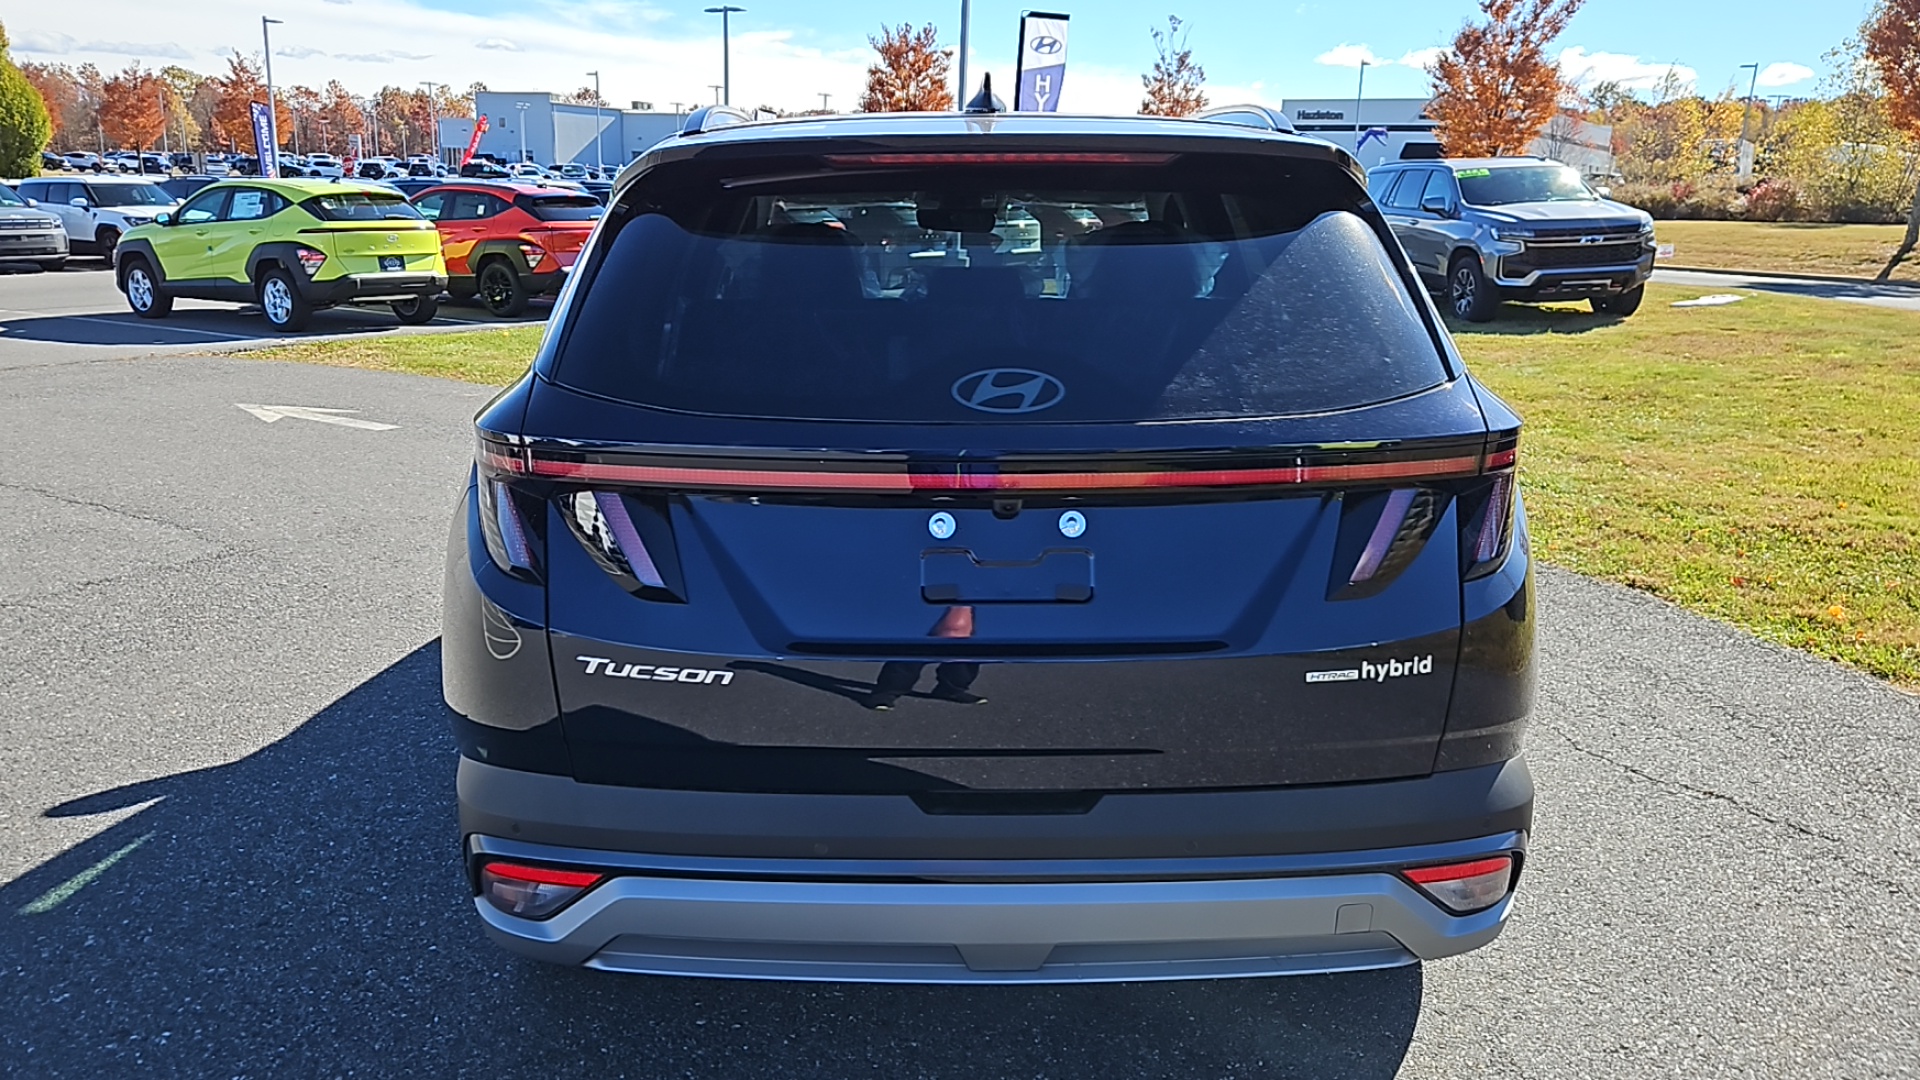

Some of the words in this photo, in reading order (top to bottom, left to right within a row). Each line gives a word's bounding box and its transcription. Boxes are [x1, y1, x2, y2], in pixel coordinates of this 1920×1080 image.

[1297, 110, 1344, 120] Hazleton
[259, 114, 275, 175] WELCOME
[1309, 671, 1357, 681] HTRAC
[1361, 654, 1433, 683] hybrid
